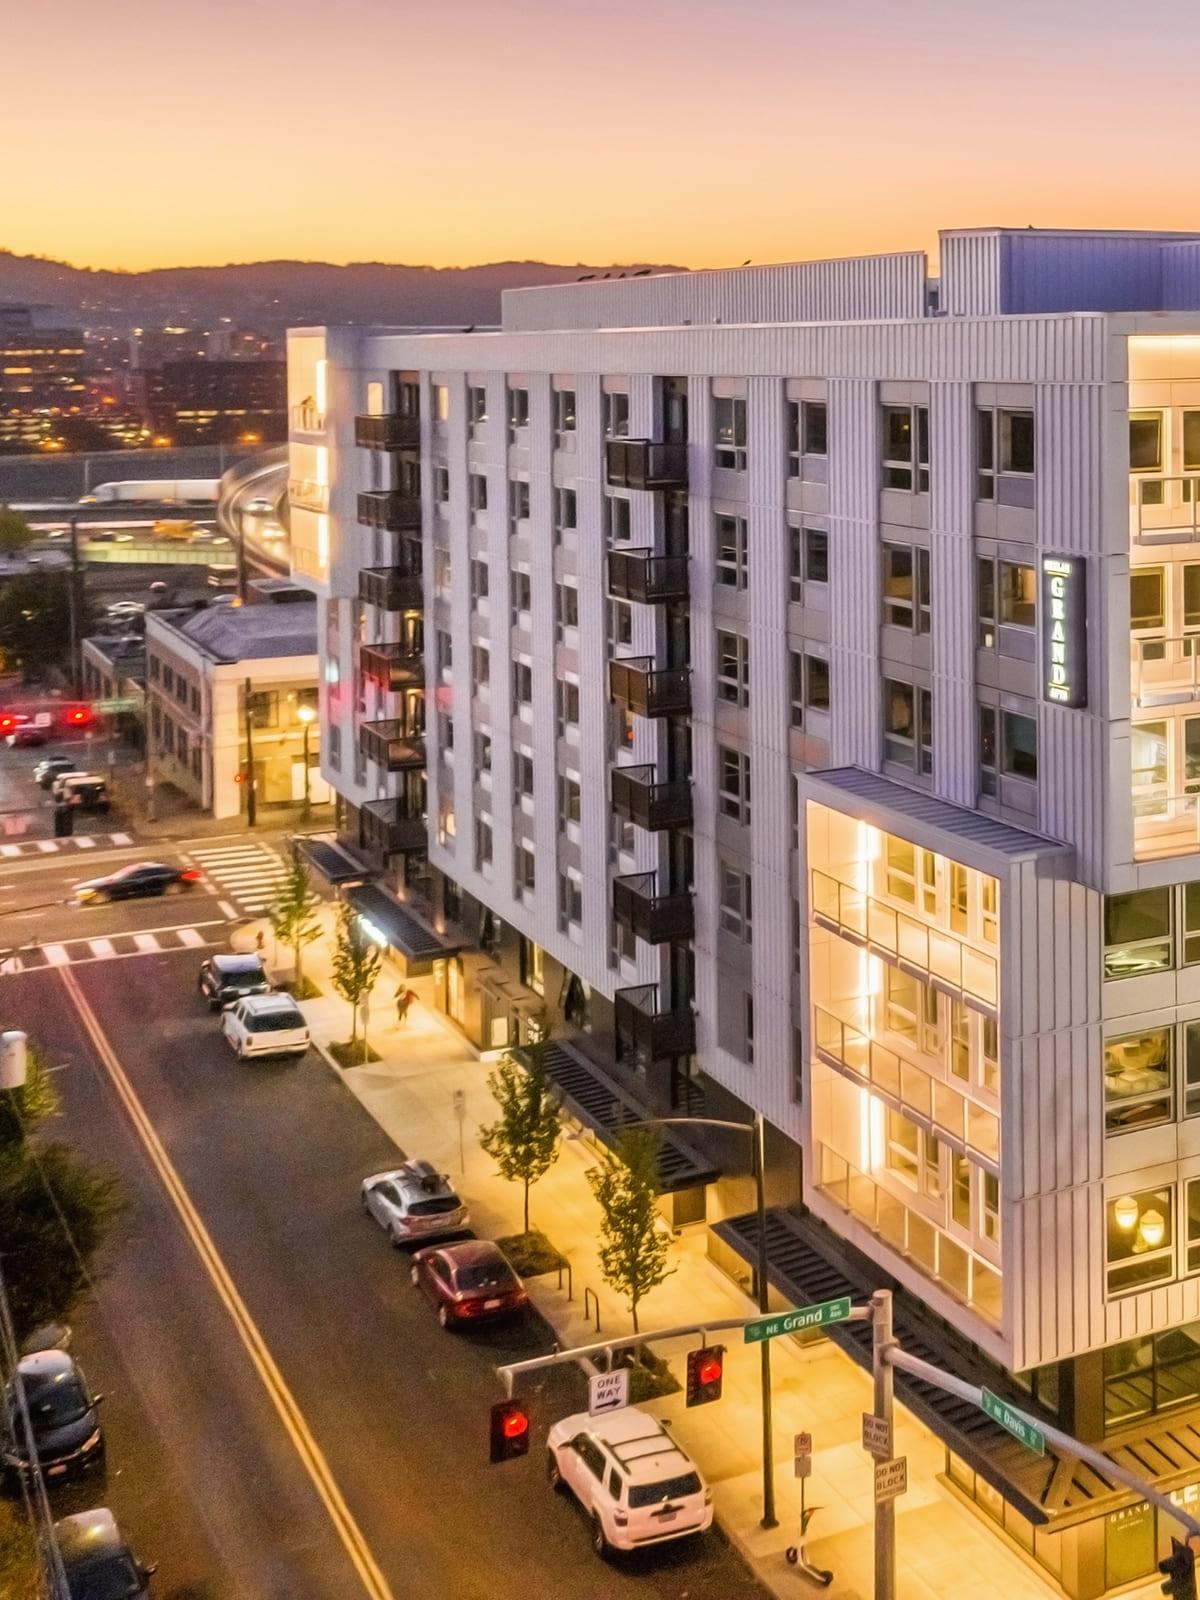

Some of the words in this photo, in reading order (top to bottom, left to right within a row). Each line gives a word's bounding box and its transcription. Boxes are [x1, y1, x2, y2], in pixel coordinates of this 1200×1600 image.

[1051, 576, 1066, 685] GRAND
[766, 1324, 779, 1335] NE
[783, 1309, 823, 1331] Grand
[597, 1375, 620, 1389] ONE
[597, 1385, 621, 1400] WAY
[875, 1423, 889, 1434] NOT
[1004, 1410, 1025, 1437] Davis
[876, 1467, 888, 1479] DO
[889, 1461, 905, 1473] NOT
[876, 1474, 905, 1491] BLOCK
